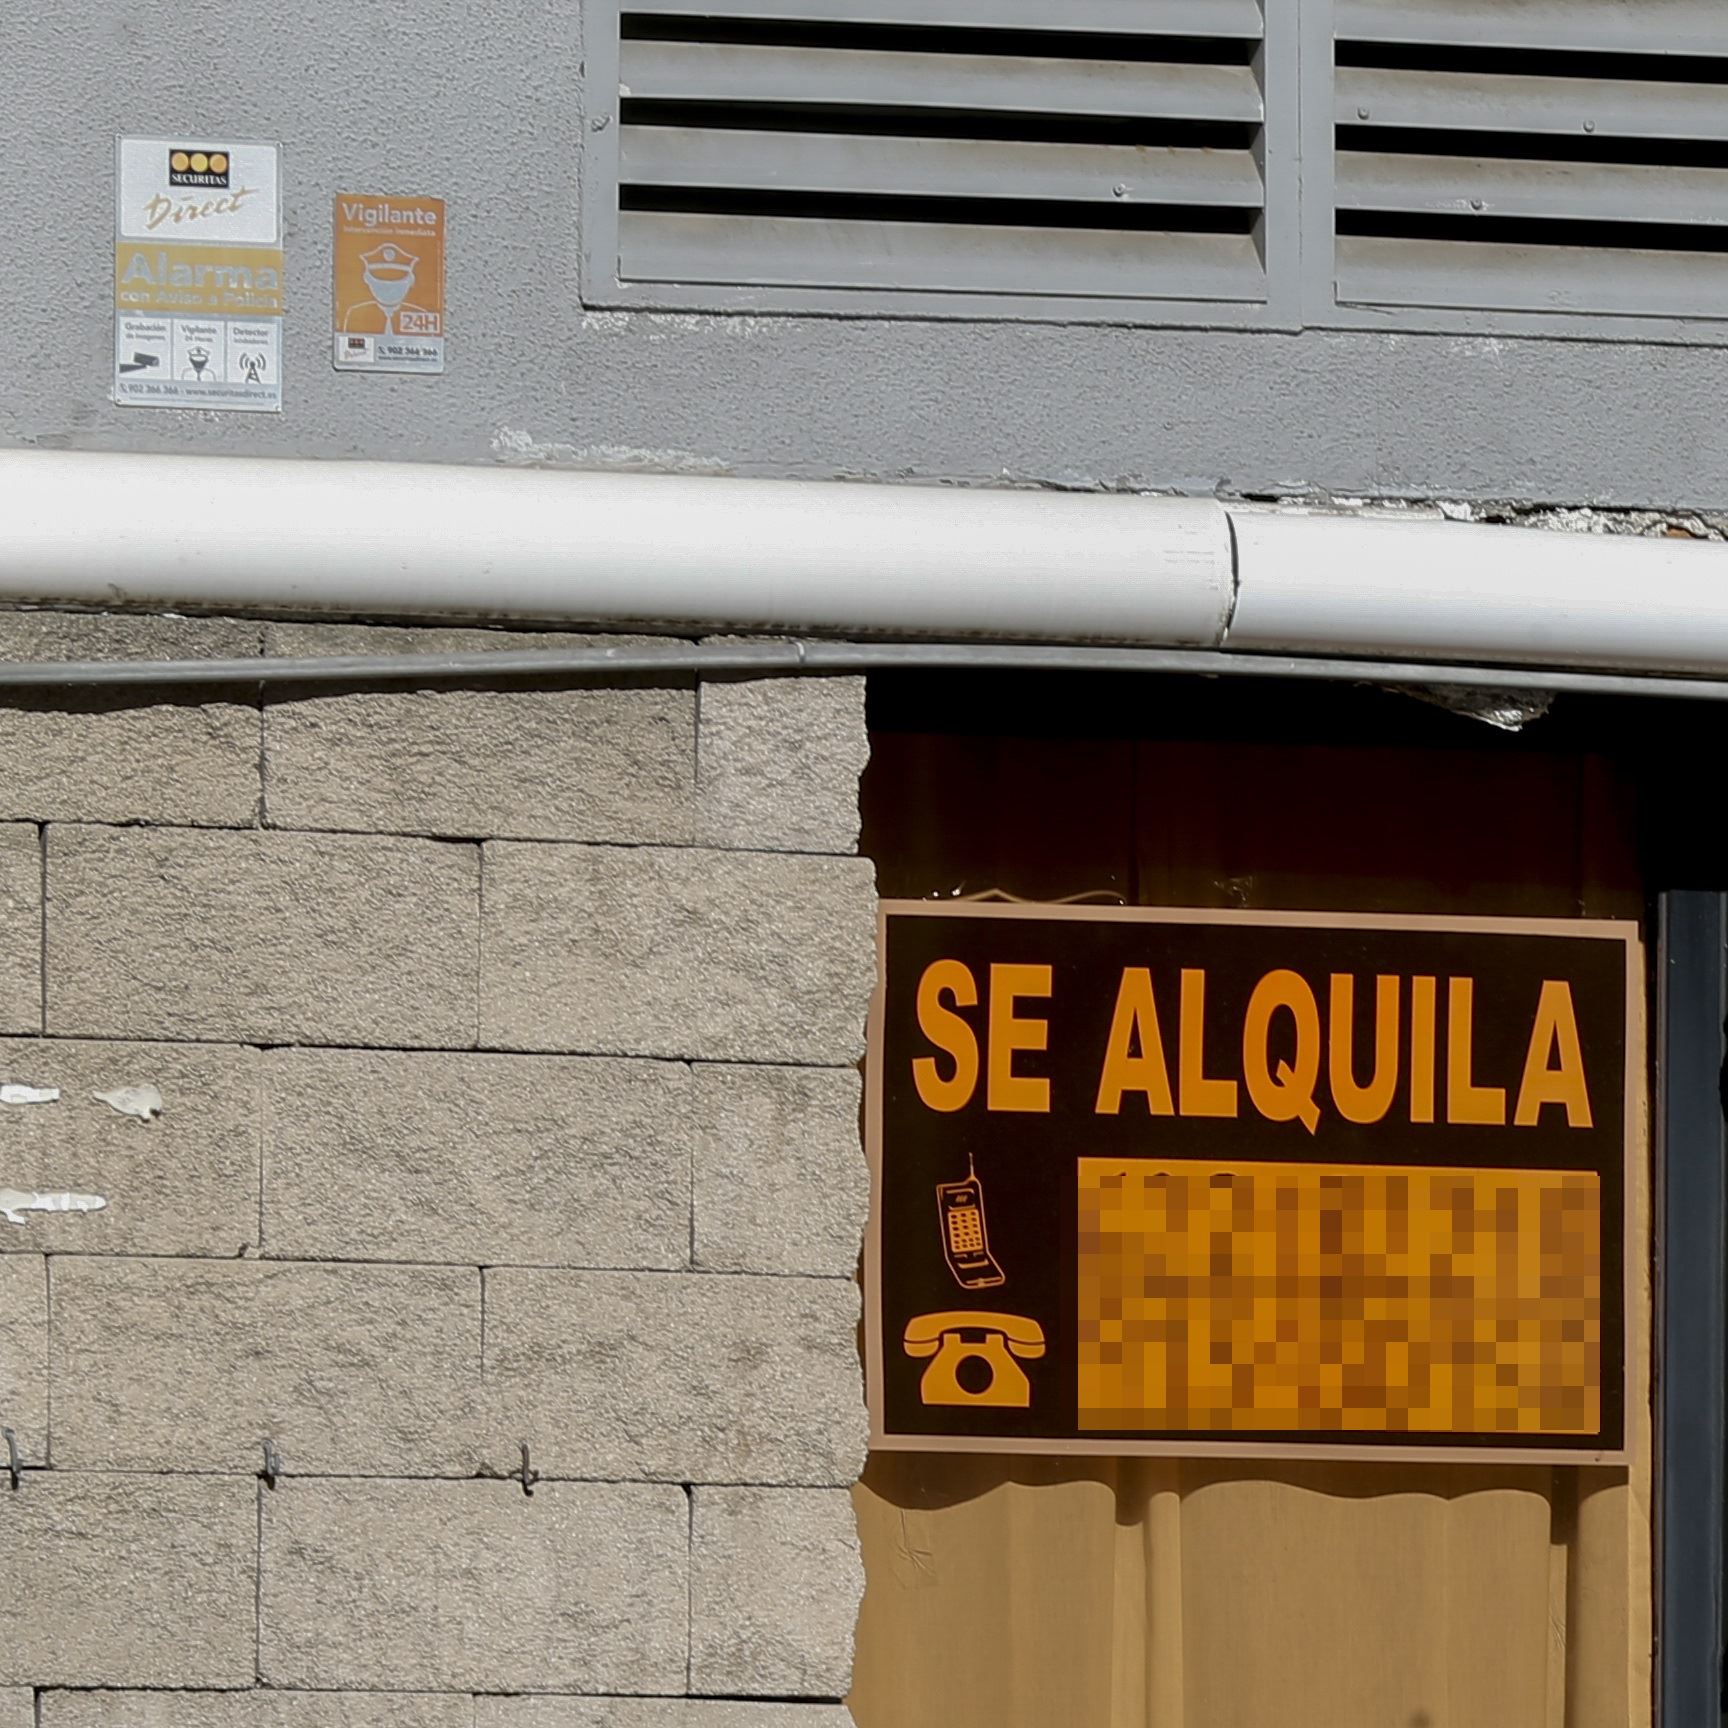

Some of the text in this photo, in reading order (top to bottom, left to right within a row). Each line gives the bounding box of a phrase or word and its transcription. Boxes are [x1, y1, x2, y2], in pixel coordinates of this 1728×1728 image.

[171, 173, 227, 185] SECURITAS
[144, 186, 259, 230] Direct
[342, 203, 437, 227] Vigilante
[121, 252, 278, 290] Alarma
[233, 327, 269, 338] Detector
[402, 314, 438, 331] 24H
[912, 959, 1593, 1135] SE ALQUILA
